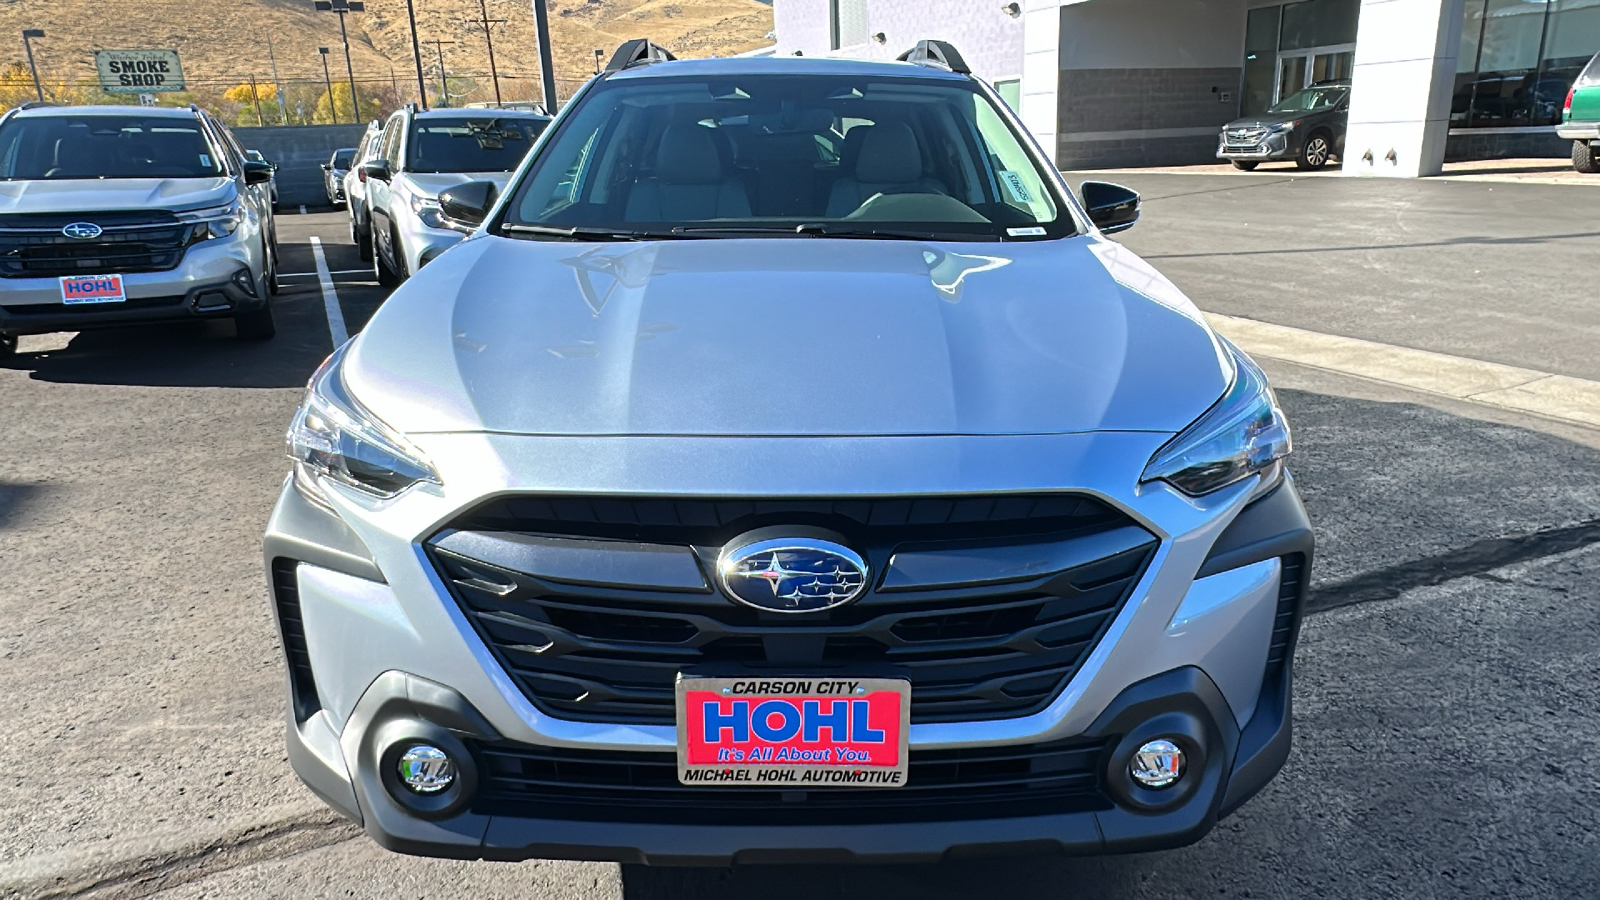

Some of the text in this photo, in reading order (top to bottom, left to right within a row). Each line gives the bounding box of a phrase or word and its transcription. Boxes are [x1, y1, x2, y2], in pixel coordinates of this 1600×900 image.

[109, 60, 170, 73] SMOKE
[118, 74, 166, 86] SHOP
[67, 281, 117, 293] HOHL
[732, 681, 860, 695] CARSON CITY
[703, 700, 885, 743] HOHL
[717, 747, 871, 761] It's All About You.
[684, 769, 902, 784] MICHAEL HOHL AUTOMOTIVE
